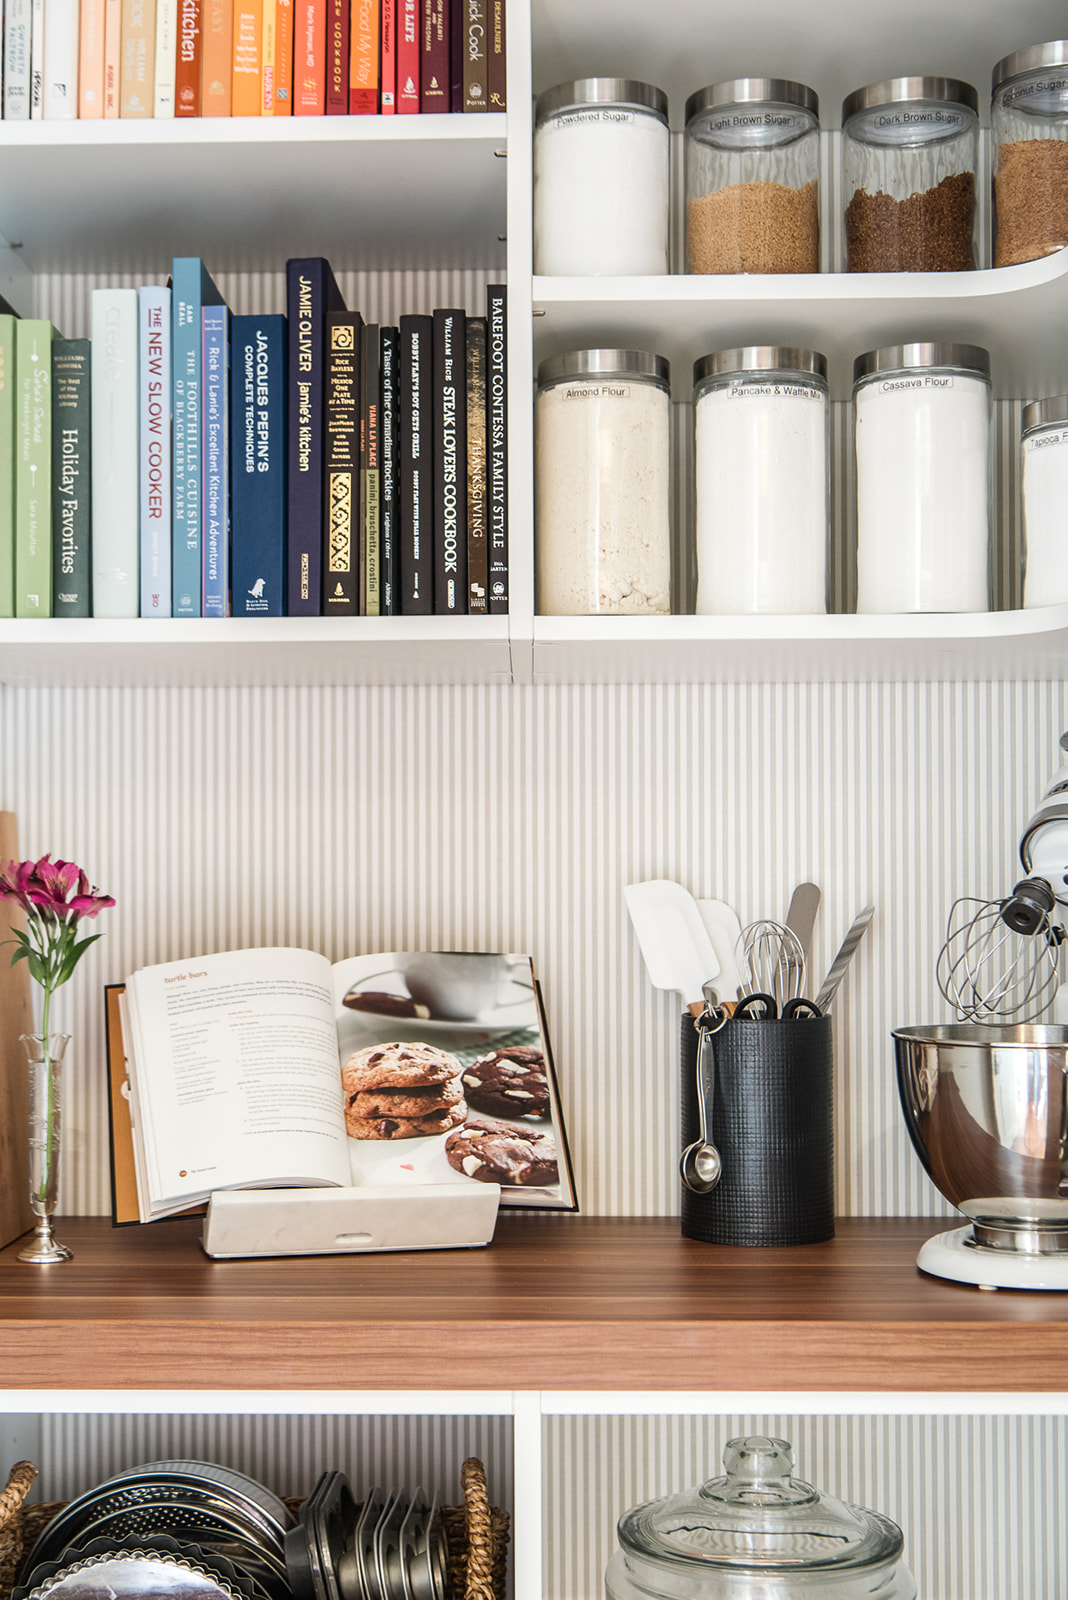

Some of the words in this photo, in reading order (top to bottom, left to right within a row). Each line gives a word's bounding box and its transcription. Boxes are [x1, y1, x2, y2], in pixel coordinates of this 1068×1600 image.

[359, 0, 373, 31] Food
[405, 13, 415, 43] LIFE
[305, 25, 315, 53] Hyman,
[356, 34, 371, 54] My
[469, 24, 485, 61] Cook
[307, 54, 314, 66] MD
[333, 22, 342, 93] COOKBOOK
[356, 57, 371, 85] Way
[1002, 86, 1034, 104] Coconut
[1036, 80, 1066, 92] Sugar
[557, 112, 599, 126] Powdered
[602, 111, 630, 122] Sugar
[710, 119, 730, 131] Light
[733, 116, 762, 126] Brown
[765, 114, 791, 125] Sugar
[880, 115, 900, 126] Dark
[903, 113, 932, 122] Brown
[935, 112, 960, 124] Sugar
[186, 305, 194, 323] SAM
[299, 276, 312, 318] JAMIE
[153, 306, 162, 327] THE
[178, 302, 186, 327] BEALL
[299, 321, 312, 372] OLIVER
[384, 338, 392, 347] A
[411, 332, 419, 360] BOBBY
[445, 317, 453, 355] WILLIAM
[492, 298, 504, 372] BAREFOOT
[149, 332, 162, 376] NEW
[187, 350, 195, 376] THE
[209, 347, 220, 371] Rick
[256, 330, 269, 406] JACQUES
[384, 348, 392, 377] Taste
[445, 359, 453, 381] RICE
[176, 380, 185, 396] OF
[209, 374, 220, 382] &
[245, 345, 254, 403] COMPLETE
[384, 379, 393, 390] of
[883, 380, 922, 392] Cassava
[925, 377, 949, 386] Flour
[149, 381, 162, 435] SLOW
[209, 385, 220, 420] Lanie's
[297, 381, 311, 424] jamie's
[384, 391, 393, 408] the
[443, 386, 456, 427] STEAK
[566, 387, 599, 398] Almond
[602, 387, 625, 396] Flour
[732, 387, 772, 396] Pancake
[774, 386, 781, 394] &
[784, 386, 809, 398] Waffle
[187, 381, 198, 472] FOOTHILLS
[492, 375, 504, 448] CONTESSA
[176, 401, 185, 480] BLACKBERRY
[209, 424, 220, 472] Excellent
[245, 405, 254, 473] TECHNIQUES
[299, 426, 312, 472] kitchen
[369, 430, 376, 440] LA
[384, 410, 393, 458] Canadian
[412, 432, 420, 459] GRILL
[58, 429, 79, 495] Holiday
[369, 442, 377, 467] PLACE
[148, 441, 162, 519] COOKER
[368, 474, 377, 504] panini,
[384, 461, 393, 501] Rockies
[472, 438, 483, 538] THANKSGIVING
[493, 451, 504, 503] FAMILY
[176, 486, 185, 520] FARM
[209, 475, 221, 517] Kitchen
[187, 479, 198, 550] CUISINE
[368, 506, 377, 557] bruschetta,
[444, 484, 457, 573] COOKBOOK
[493, 506, 504, 548] STYLE
[62, 500, 79, 574] Favorites
[209, 520, 220, 580] Adventures
[164, 974, 187, 984] turtle
[189, 971, 208, 979] bars
